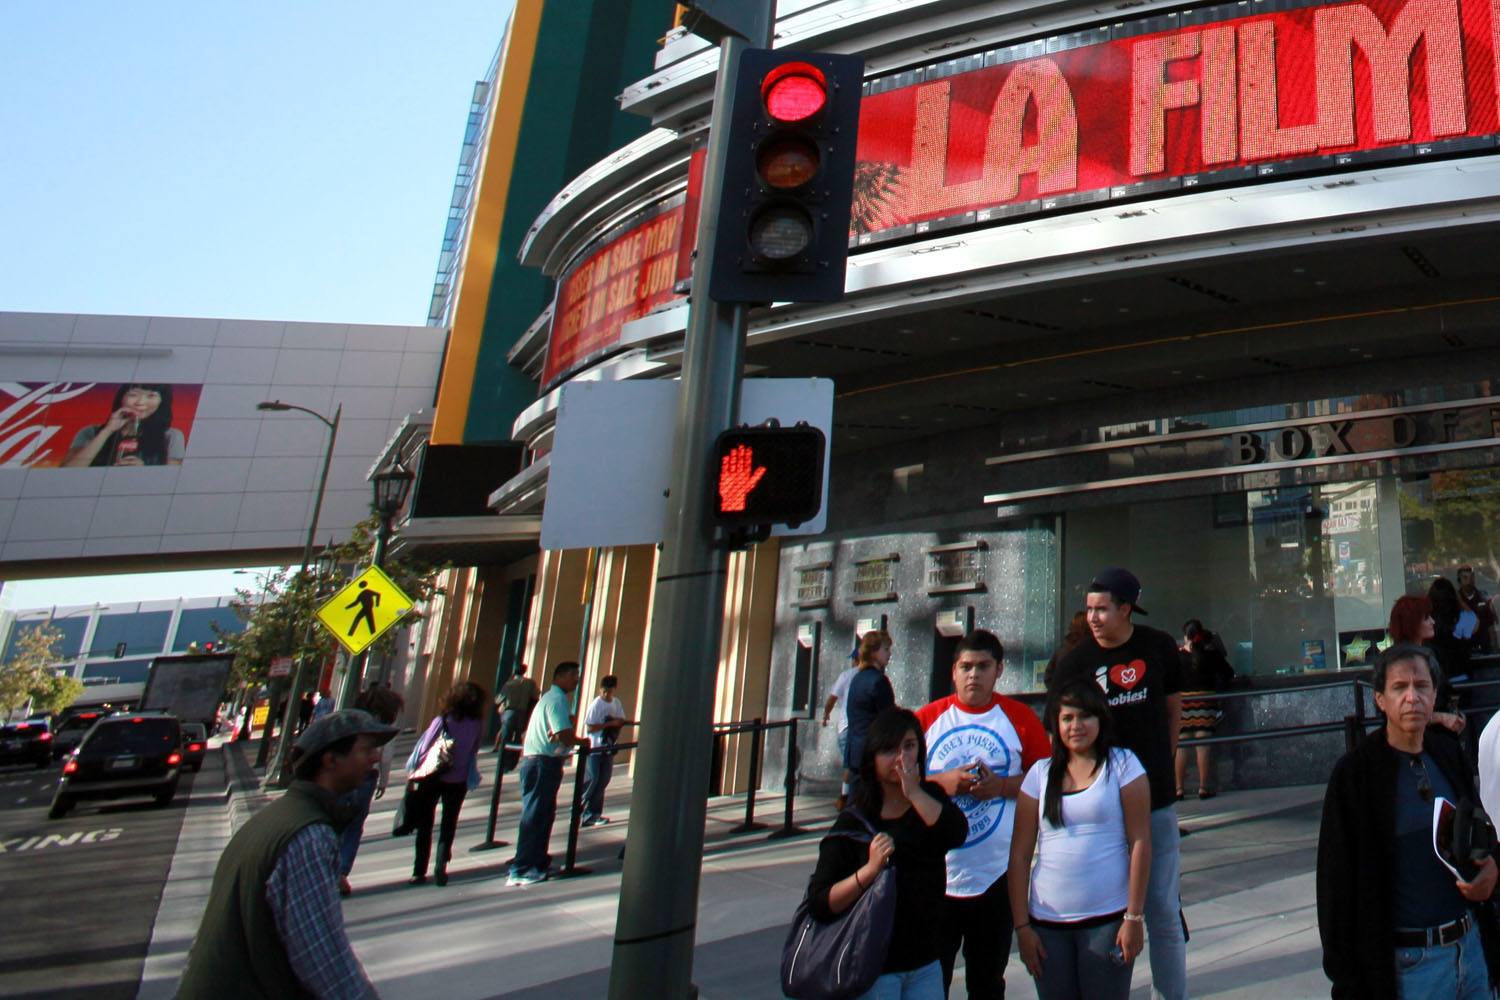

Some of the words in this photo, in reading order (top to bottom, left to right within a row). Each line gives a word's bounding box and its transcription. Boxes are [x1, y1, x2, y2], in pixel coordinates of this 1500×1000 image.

[906, 56, 1079, 220] LA
[643, 215, 679, 260] MAY
[1232, 421, 1354, 466] BOX
